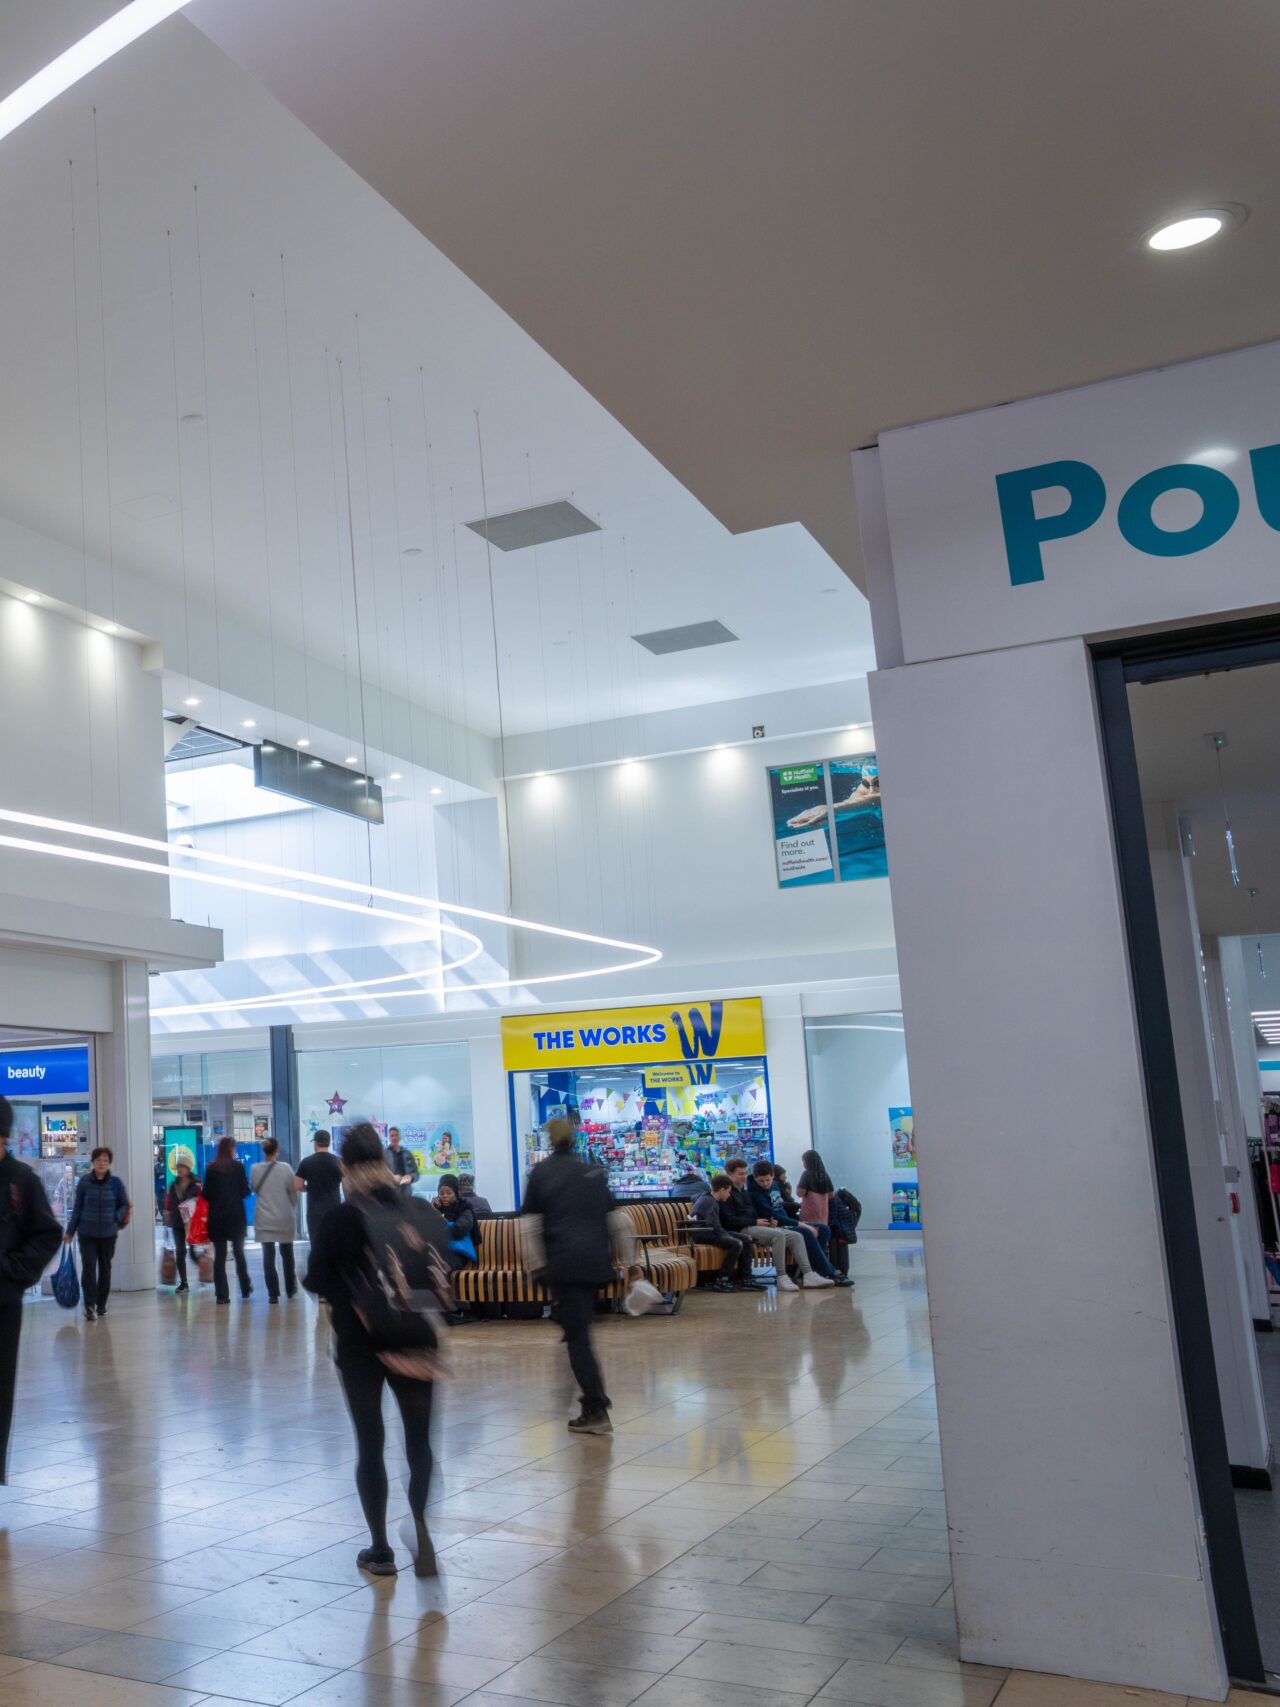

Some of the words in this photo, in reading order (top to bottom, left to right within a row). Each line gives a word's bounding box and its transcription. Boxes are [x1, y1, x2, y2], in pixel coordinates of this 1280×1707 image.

[780, 840, 799, 850] Find
[533, 1030, 575, 1051] THE
[578, 1023, 667, 1048] WORKS
[8, 1065, 46, 1080] beauty
